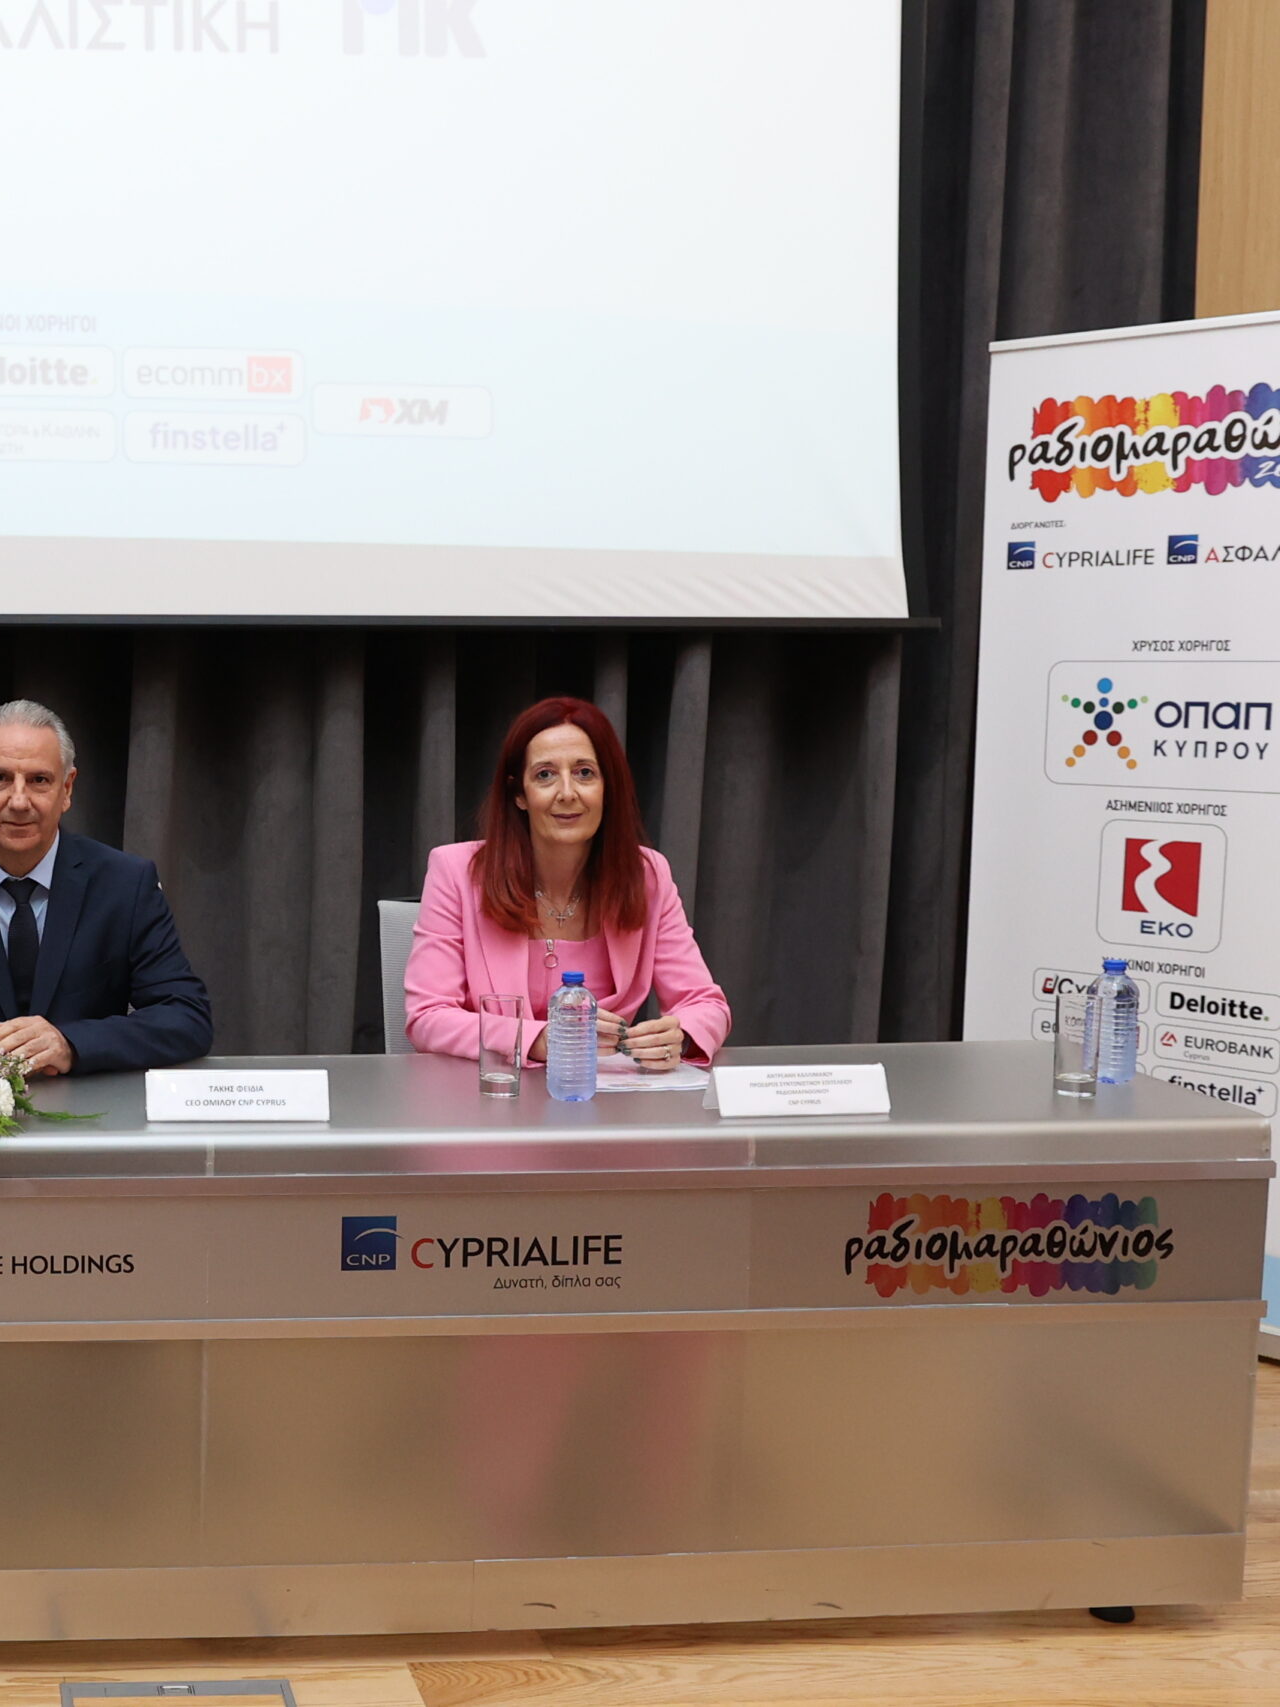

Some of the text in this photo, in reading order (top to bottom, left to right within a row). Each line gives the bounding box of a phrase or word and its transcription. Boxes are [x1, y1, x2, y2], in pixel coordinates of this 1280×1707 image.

[394, 398, 449, 426] XM
[1009, 549, 1154, 569] CNP CYPRIALIFE
[1169, 554, 1195, 563] CNP
[1132, 640, 1231, 652] ΧΡΥΣΟΣ ΧΟΡΗΓΟΣ
[1153, 740, 1269, 760] ΚΥΠΡΟΥ
[1176, 802, 1227, 816] ΧΟΡΗΓΟΣ
[1140, 920, 1193, 938] EKO
[1157, 961, 1206, 978] ΧΟΡΗΓΟΙ
[1184, 1035, 1274, 1060] EUROBANK
[346, 1234, 623, 1269] CNP CYPRIALIFE
[12, 1254, 135, 1275] HOLDINGS
[595, 1277, 622, 1289] σας
